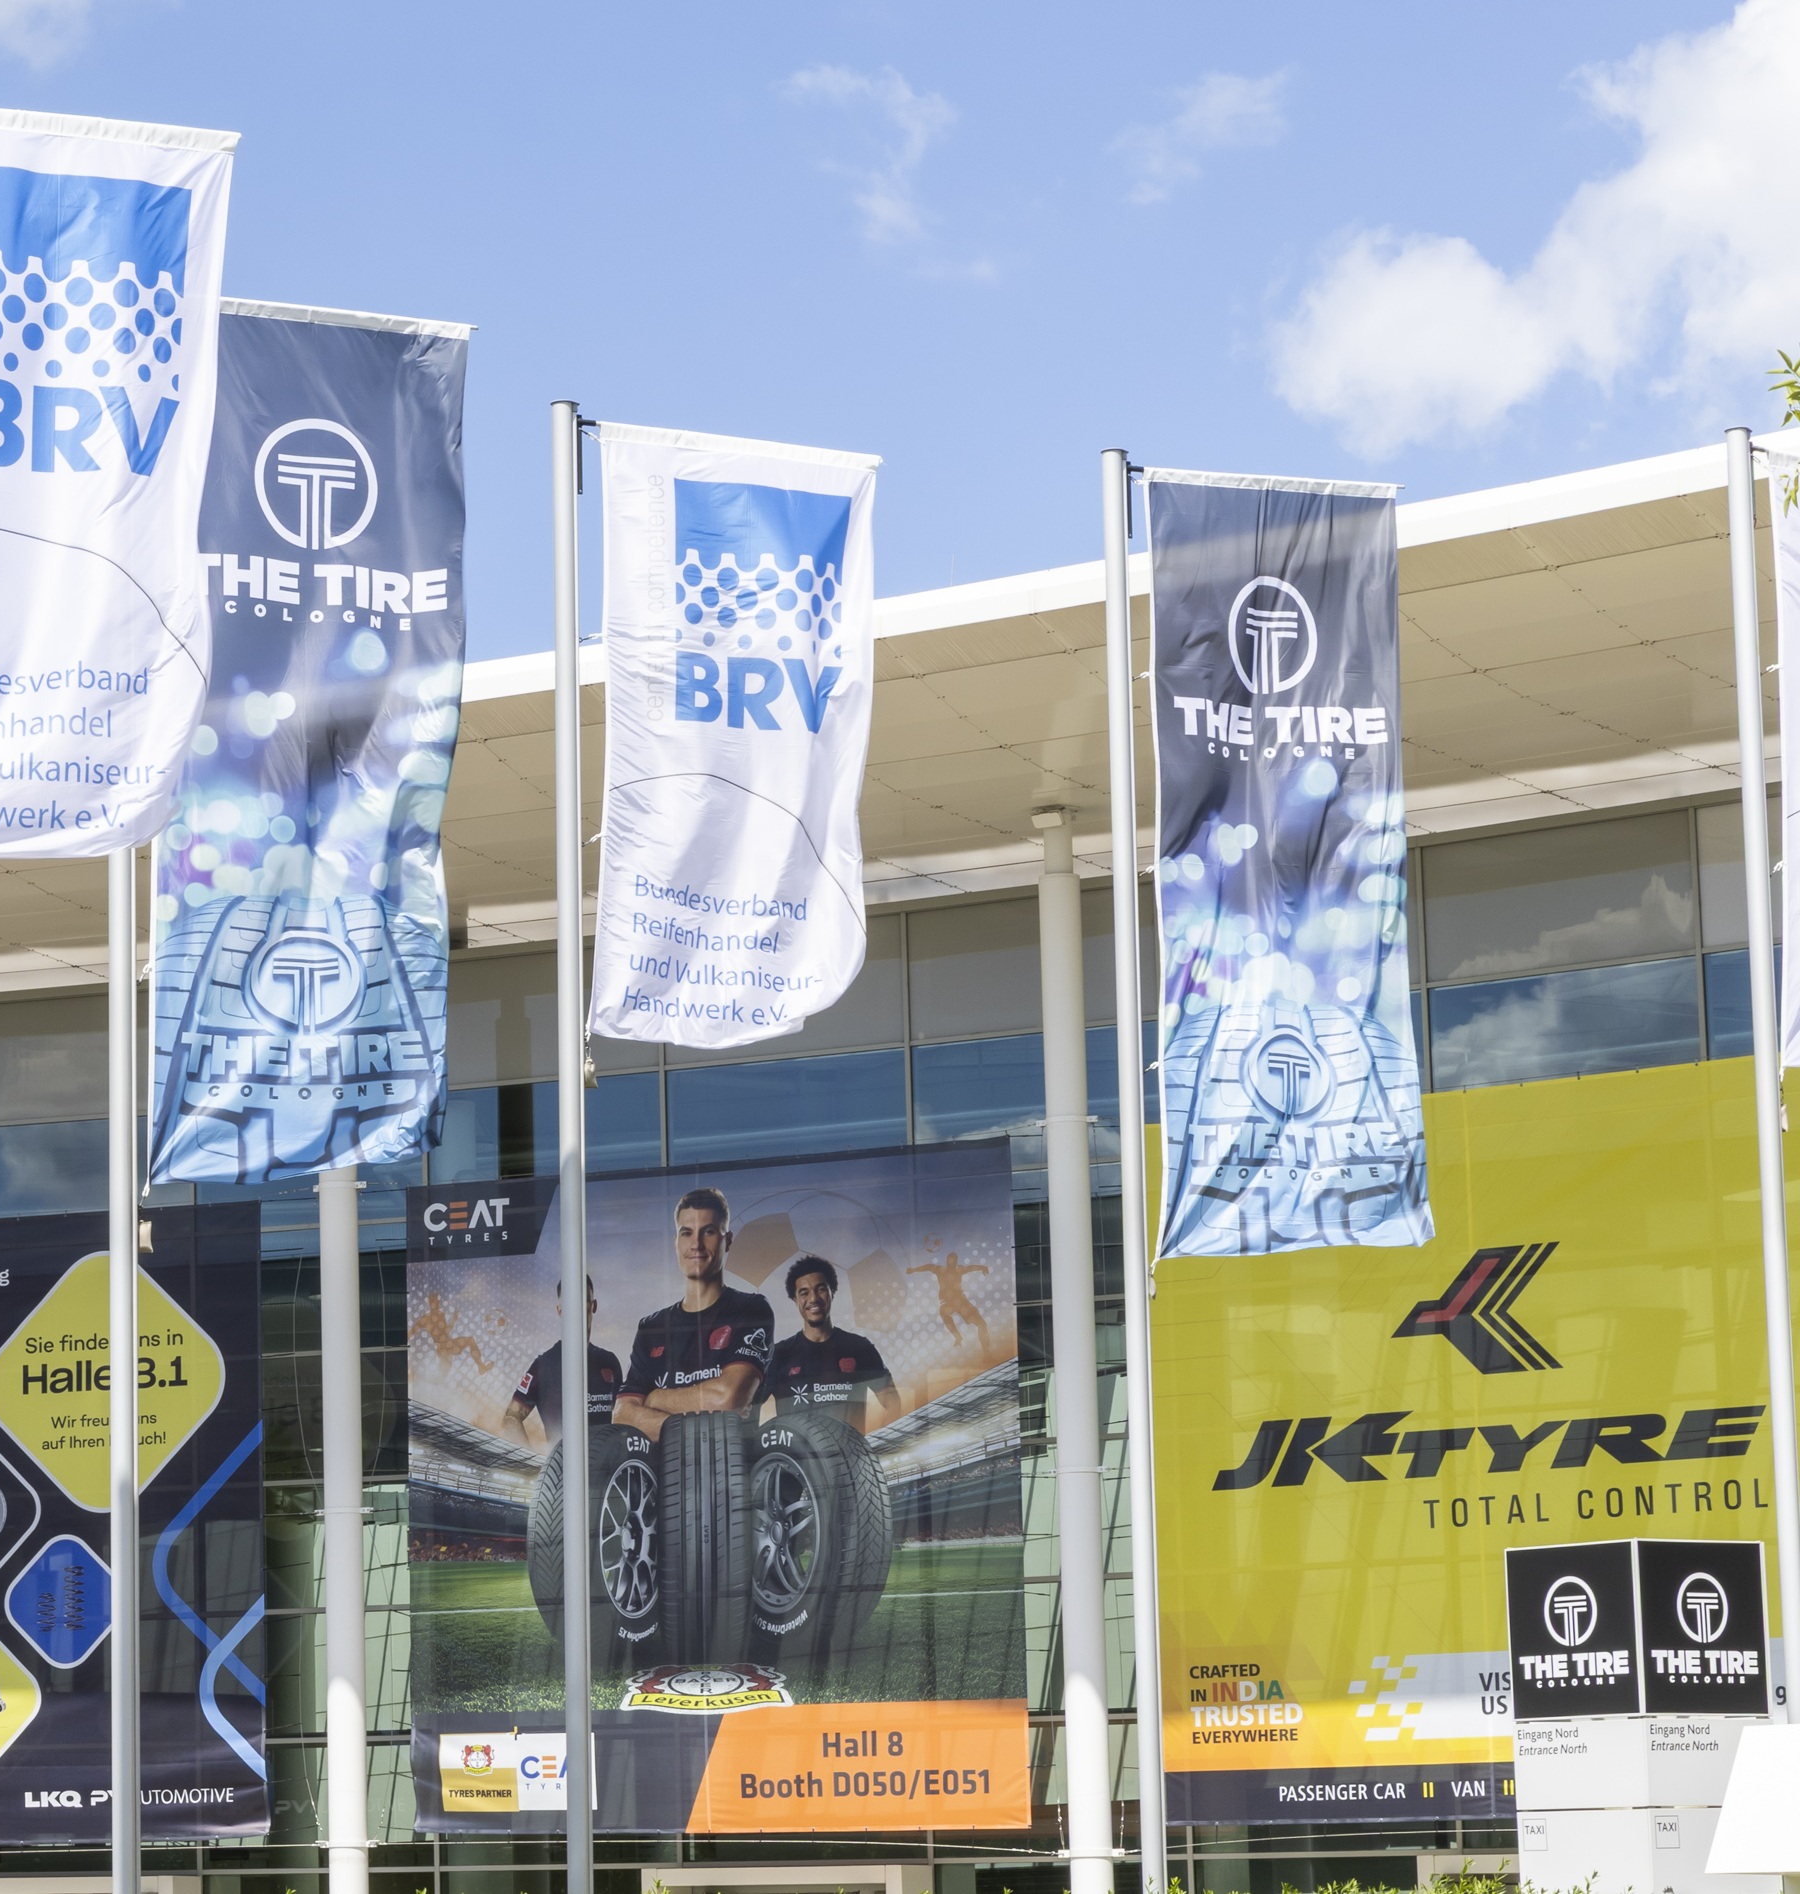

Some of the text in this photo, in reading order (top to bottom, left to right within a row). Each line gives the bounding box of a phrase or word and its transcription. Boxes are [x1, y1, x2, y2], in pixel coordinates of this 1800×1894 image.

[314, 564, 448, 614] TIRE
[224, 600, 412, 631] COLOGNE
[675, 650, 843, 734] BRV
[1174, 696, 1388, 745] THE TIRE
[1208, 742, 1355, 761] COLOGNE
[74, 803, 126, 830] e.V.
[635, 874, 807, 921] Bundesverband
[633, 912, 780, 954] Reifenhandel
[629, 954, 823, 992] und Vulkaniseur-
[622, 986, 744, 1023] Handwerk
[181, 1030, 429, 1077] THE TIRE
[208, 1083, 395, 1100] COLOGNE
[1188, 1121, 1408, 1164] THE TIRE
[1214, 1166, 1380, 1181] COLOGNE
[424, 1198, 510, 1232] CEAT
[429, 1231, 508, 1245] TYRES
[25, 1336, 55, 1354] Sie
[59, 1333, 109, 1352] finde
[166, 1329, 183, 1345] in
[22, 1360, 111, 1395] Halle
[51, 1416, 77, 1429] Wir
[42, 1436, 66, 1450] auf
[69, 1435, 105, 1449] Ihren
[627, 1436, 650, 1454] CEAT
[761, 1429, 793, 1448] CEAT
[1423, 1478, 1769, 1529] TOTAL CONTROL
[1189, 1663, 1261, 1679] CRAFTED
[1519, 1650, 1630, 1680] THE TIRE
[1651, 1650, 1759, 1675] THE TIRE
[1536, 1676, 1615, 1688] COLOGNE
[1669, 1675, 1746, 1684] COLOGNE
[641, 1693, 771, 1707] Leverkusen
[1190, 1680, 1285, 1702] IN INDIA
[1190, 1703, 1304, 1728] TRUSTED
[1481, 1695, 1508, 1715] US
[1192, 1728, 1299, 1744] EVERYWHERE
[1518, 1727, 1579, 1743] Eingang Nord
[1650, 1724, 1710, 1738] Eingang Nord
[822, 1730, 904, 1758] Hall 8
[1519, 1743, 1587, 1756] Entrance North
[1651, 1740, 1719, 1751] Entrance North
[449, 1789, 512, 1798] TYRES PARTNER
[740, 1769, 990, 1800] Booth D050/E051
[1279, 1780, 1486, 1802] PASSENGER CAR VAN
[24, 1790, 83, 1808] LKQ
[140, 1788, 234, 1806] UTOMOTIVE
[1525, 1825, 1545, 1836] TAXI
[1656, 1823, 1677, 1832] TAXI
